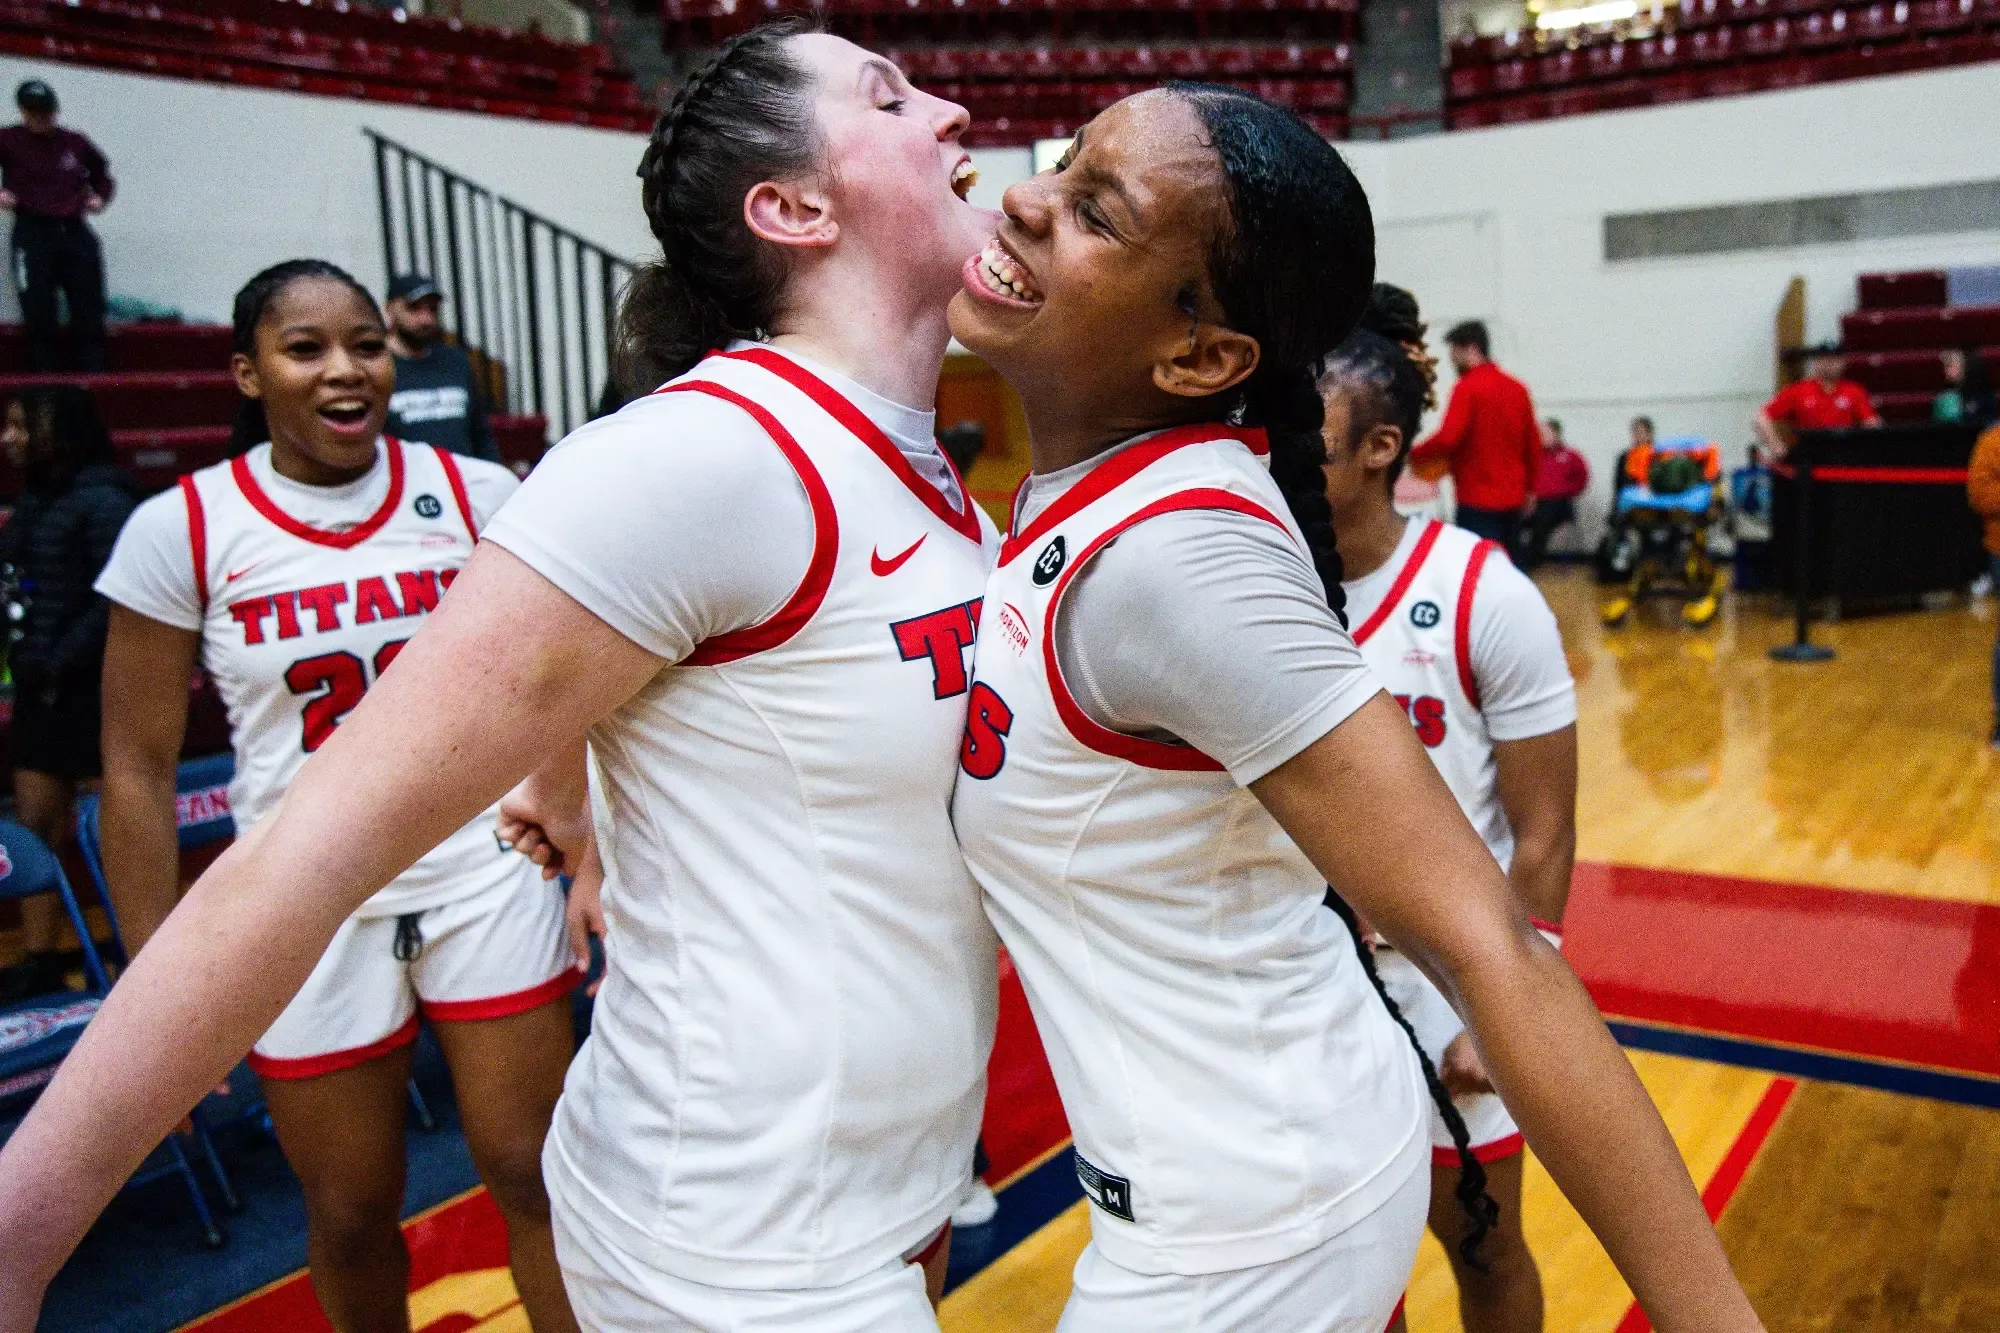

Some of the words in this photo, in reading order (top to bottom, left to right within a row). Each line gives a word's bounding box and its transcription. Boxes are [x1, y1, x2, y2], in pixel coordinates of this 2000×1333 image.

[1038, 543, 1061, 574] EC
[1414, 604, 1436, 624] EC
[999, 607, 1029, 650] HORIZON
[1105, 1188, 1121, 1208] M
